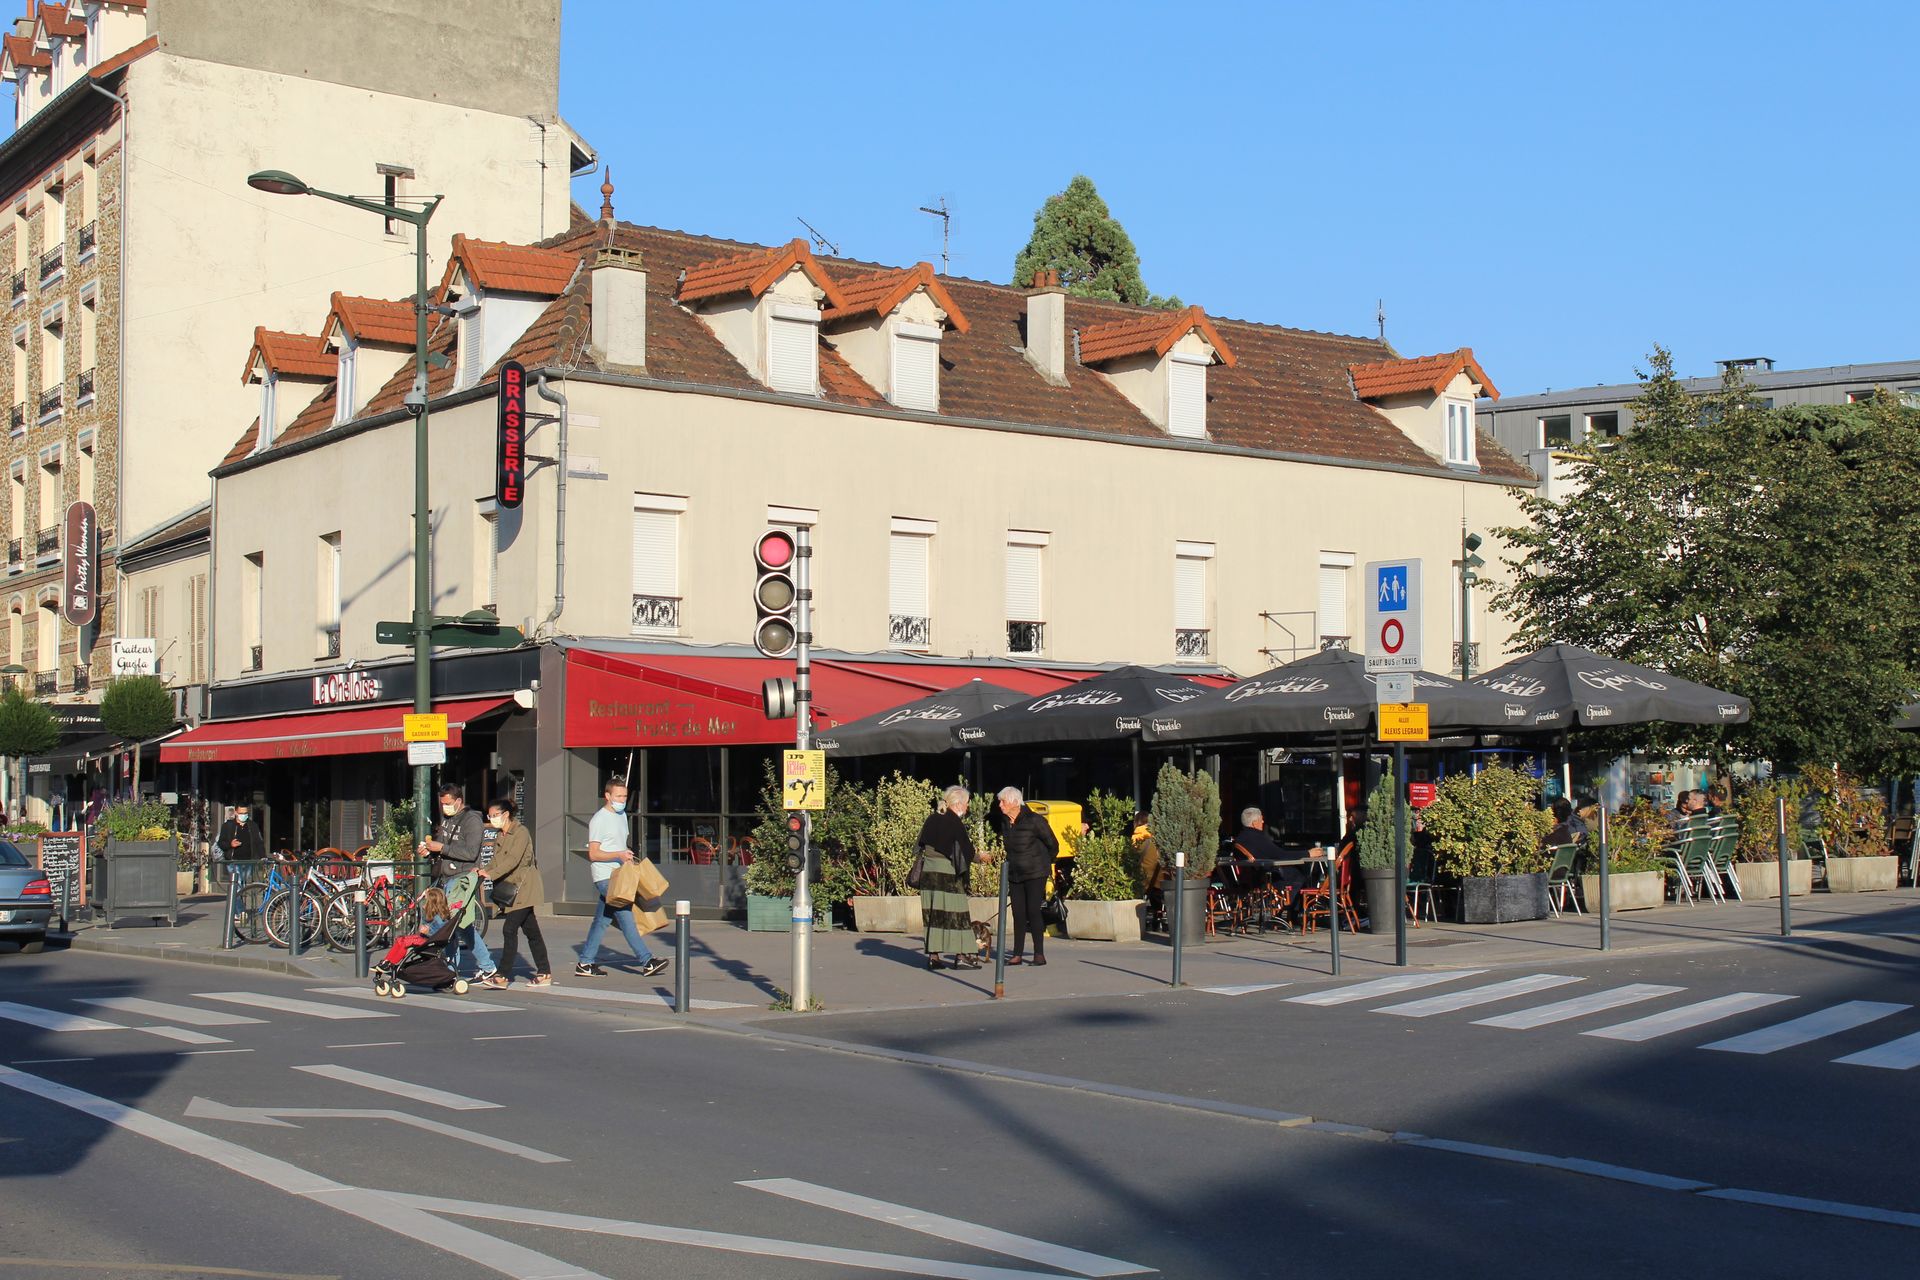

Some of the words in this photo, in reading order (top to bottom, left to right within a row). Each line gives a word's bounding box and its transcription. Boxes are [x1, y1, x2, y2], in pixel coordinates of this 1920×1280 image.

[504, 369, 520, 501] BRASSERIE
[70, 517, 88, 557] Woman
[74, 558, 90, 593] Pretty
[112, 641, 153, 655] Traiteur
[1369, 659, 1382, 667] SAUF
[1384, 658, 1396, 666] BUS
[1402, 657, 1417, 665] TAXIS
[1225, 678, 1330, 702] Goudale
[1473, 678, 1546, 698] dale
[1577, 671, 1668, 692] Goule
[589, 699, 671, 717] Restaurant
[1027, 693, 1123, 713] Goudale
[1504, 702, 1527, 720] Goudale
[1586, 703, 1612, 721] Goudale
[76, 715, 103, 723] Woma
[1323, 706, 1355, 724] Goudale
[635, 719, 679, 737] Fruits
[681, 718, 702, 736] de
[707, 716, 736, 736] Mer
[958, 727, 986, 743] Goudale
[1151, 718, 1182, 736] Goudale
[815, 738, 840, 751] Goudale
